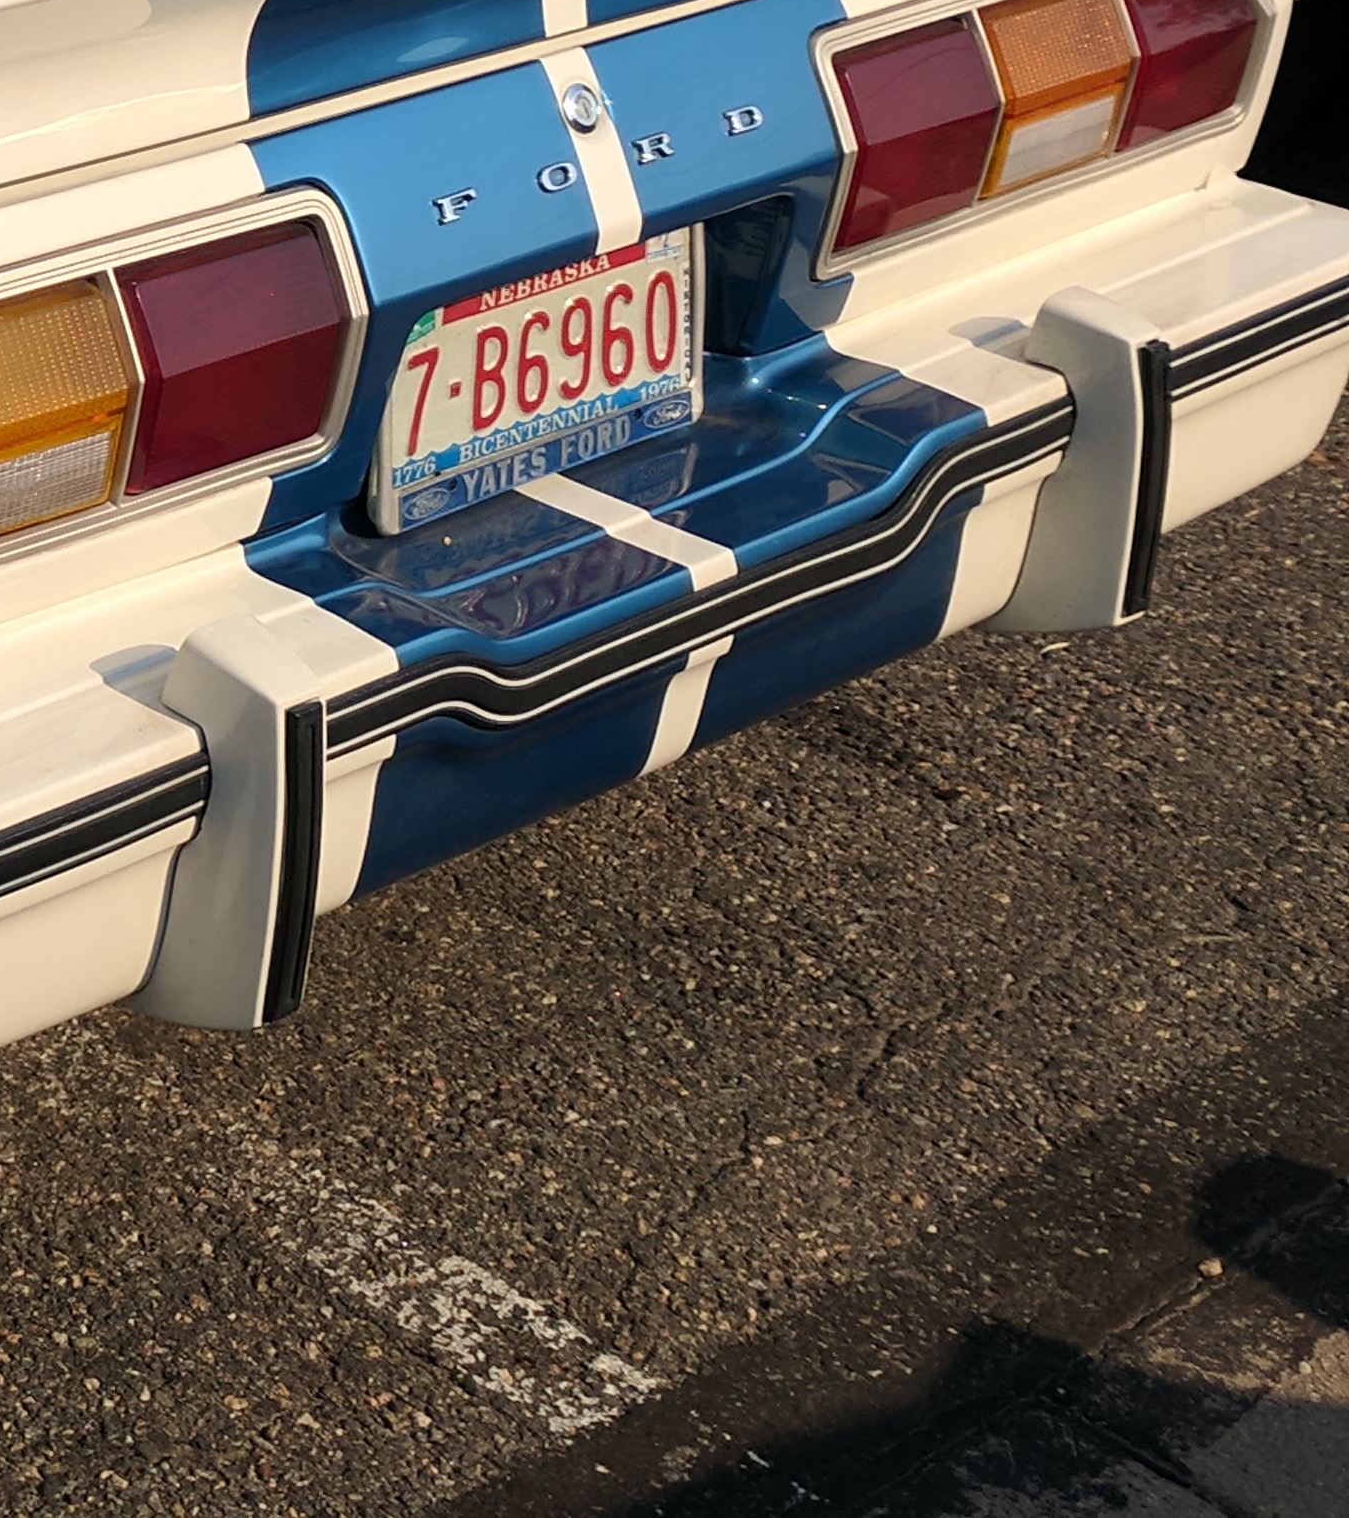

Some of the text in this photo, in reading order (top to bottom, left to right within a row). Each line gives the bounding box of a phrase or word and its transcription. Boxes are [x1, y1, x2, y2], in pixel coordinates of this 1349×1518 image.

[479, 254, 611, 311] NEBRASKA
[407, 270, 677, 458] 7-B6960
[393, 376, 681, 486] 1776 BICENTENNIAL 1976
[462, 446, 547, 502] YATES
[560, 415, 632, 467] FORD
